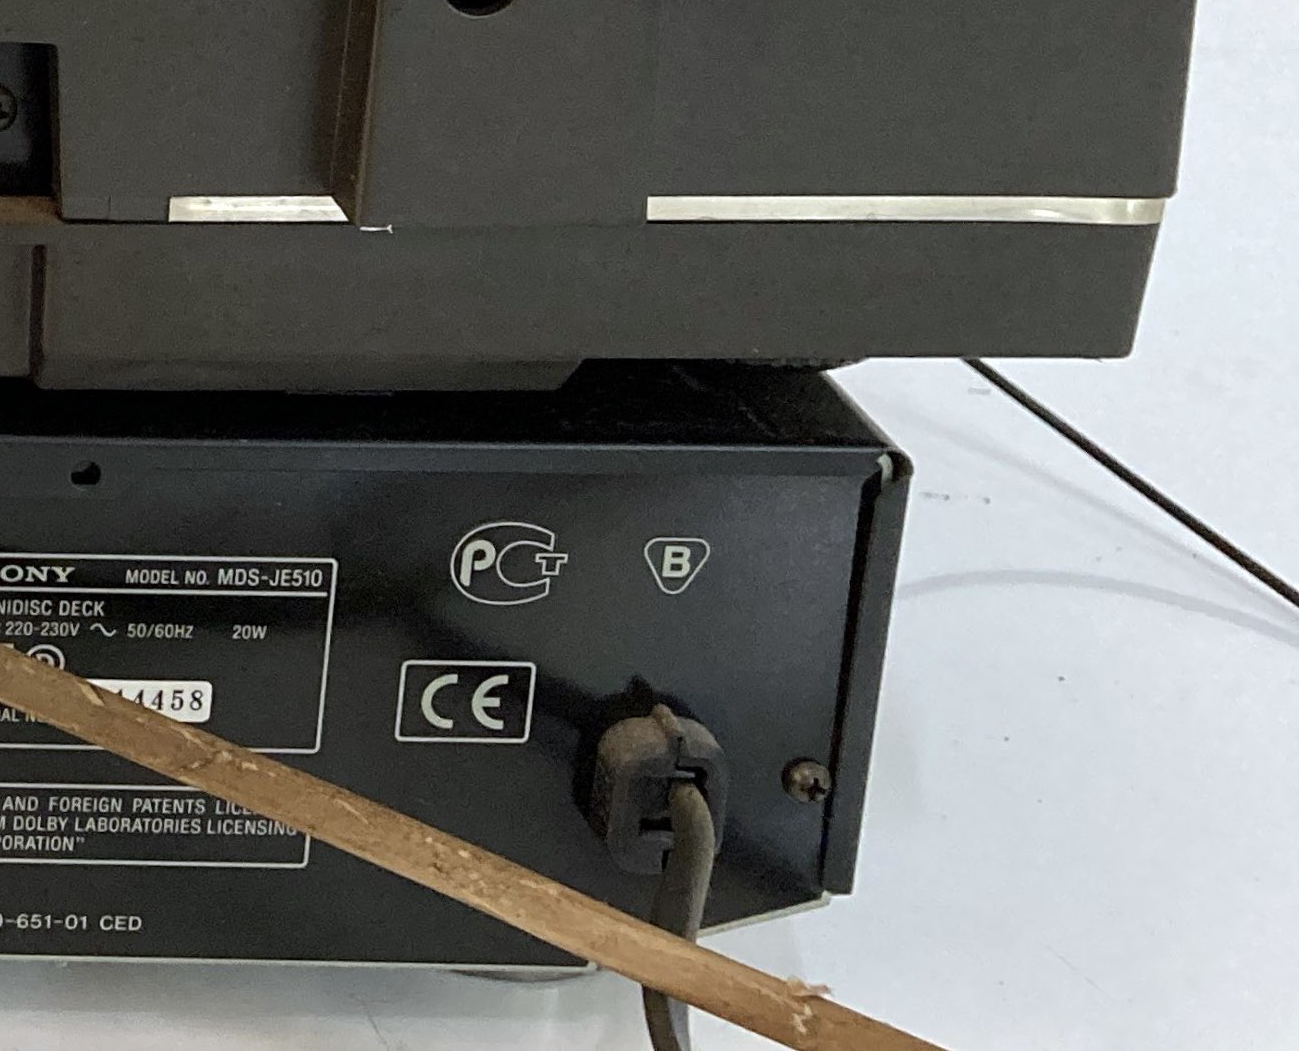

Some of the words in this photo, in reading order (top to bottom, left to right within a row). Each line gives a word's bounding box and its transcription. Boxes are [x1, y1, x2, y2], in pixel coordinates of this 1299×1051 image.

[662, 546, 691, 578] B
[125, 569, 179, 585] MODEL
[184, 570, 210, 585] NO.
[217, 568, 323, 588] MDS-JE510
[59, 601, 105, 617] DECK
[5, 621, 80, 637] 220-230V
[232, 625, 267, 641] 20W
[421, 674, 509, 730] CE
[2, 795, 39, 812] AND
[49, 796, 123, 813] FOREIGN
[132, 798, 206, 815] PATENTS
[13, 816, 69, 833] DOLBY
[74, 817, 201, 835] LABORATORIES
[99, 915, 142, 931] CED
